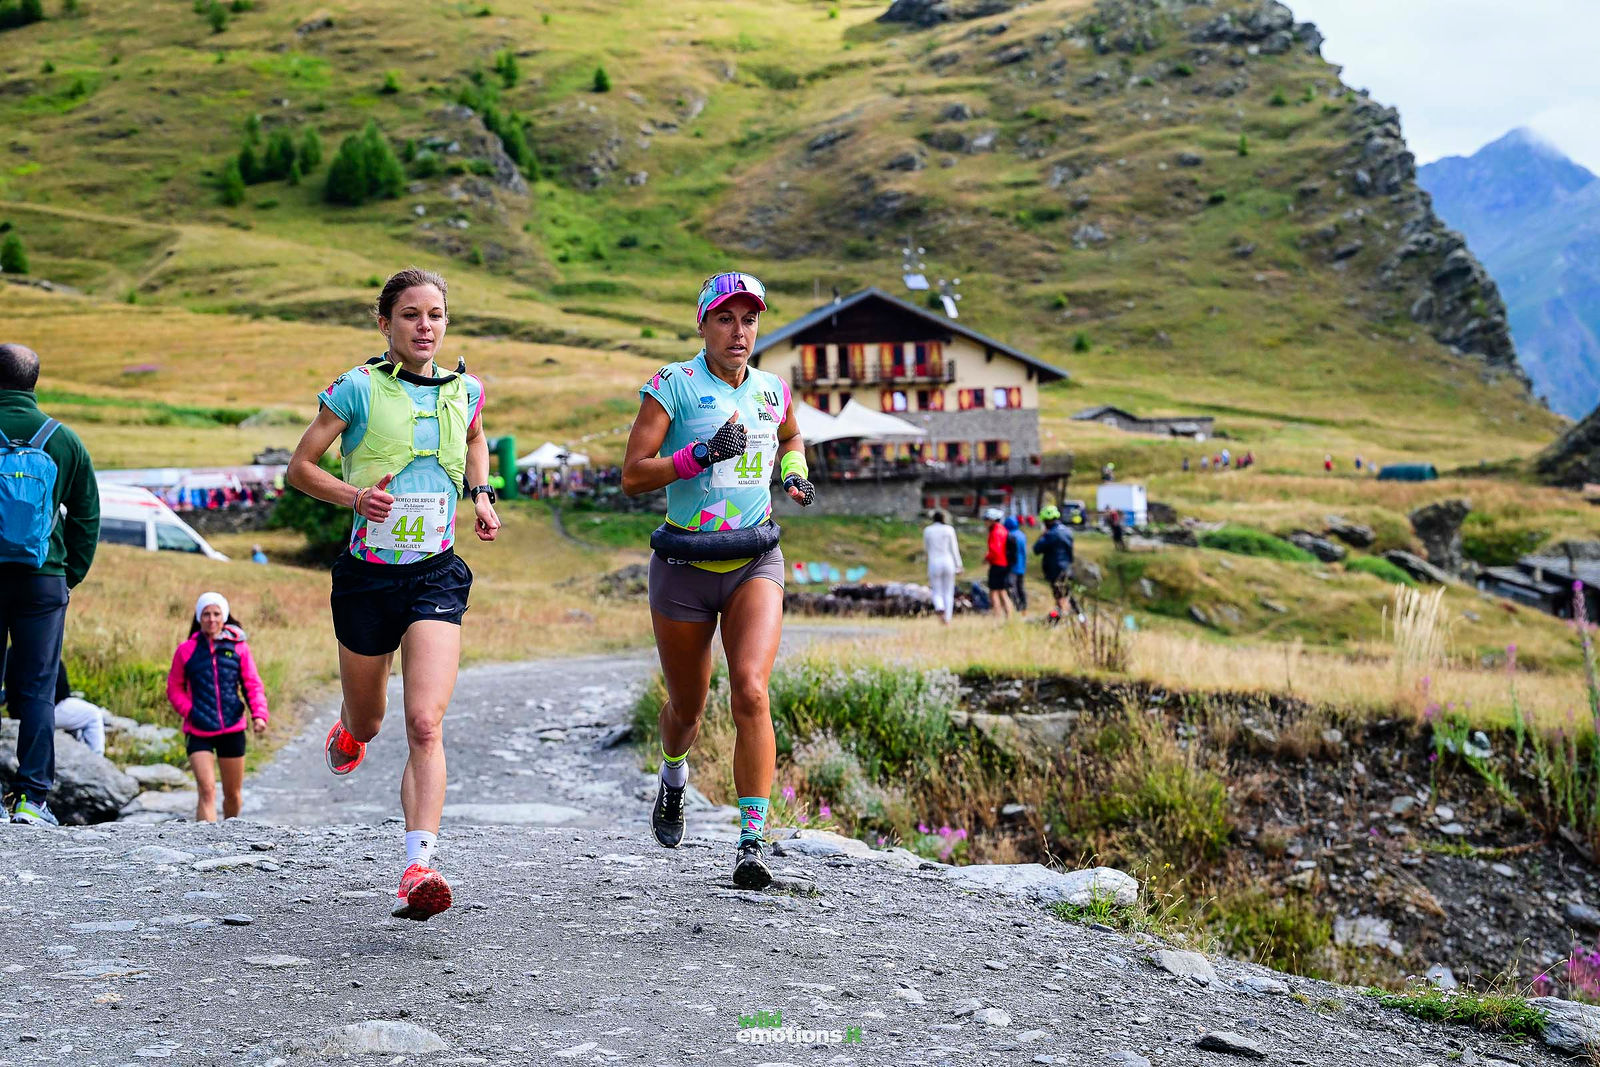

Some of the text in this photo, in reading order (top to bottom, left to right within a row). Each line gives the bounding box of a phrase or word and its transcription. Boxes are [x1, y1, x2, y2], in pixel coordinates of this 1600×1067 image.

[763, 390, 779, 407] ALI
[734, 451, 763, 478] 44
[391, 515, 425, 542] 44
